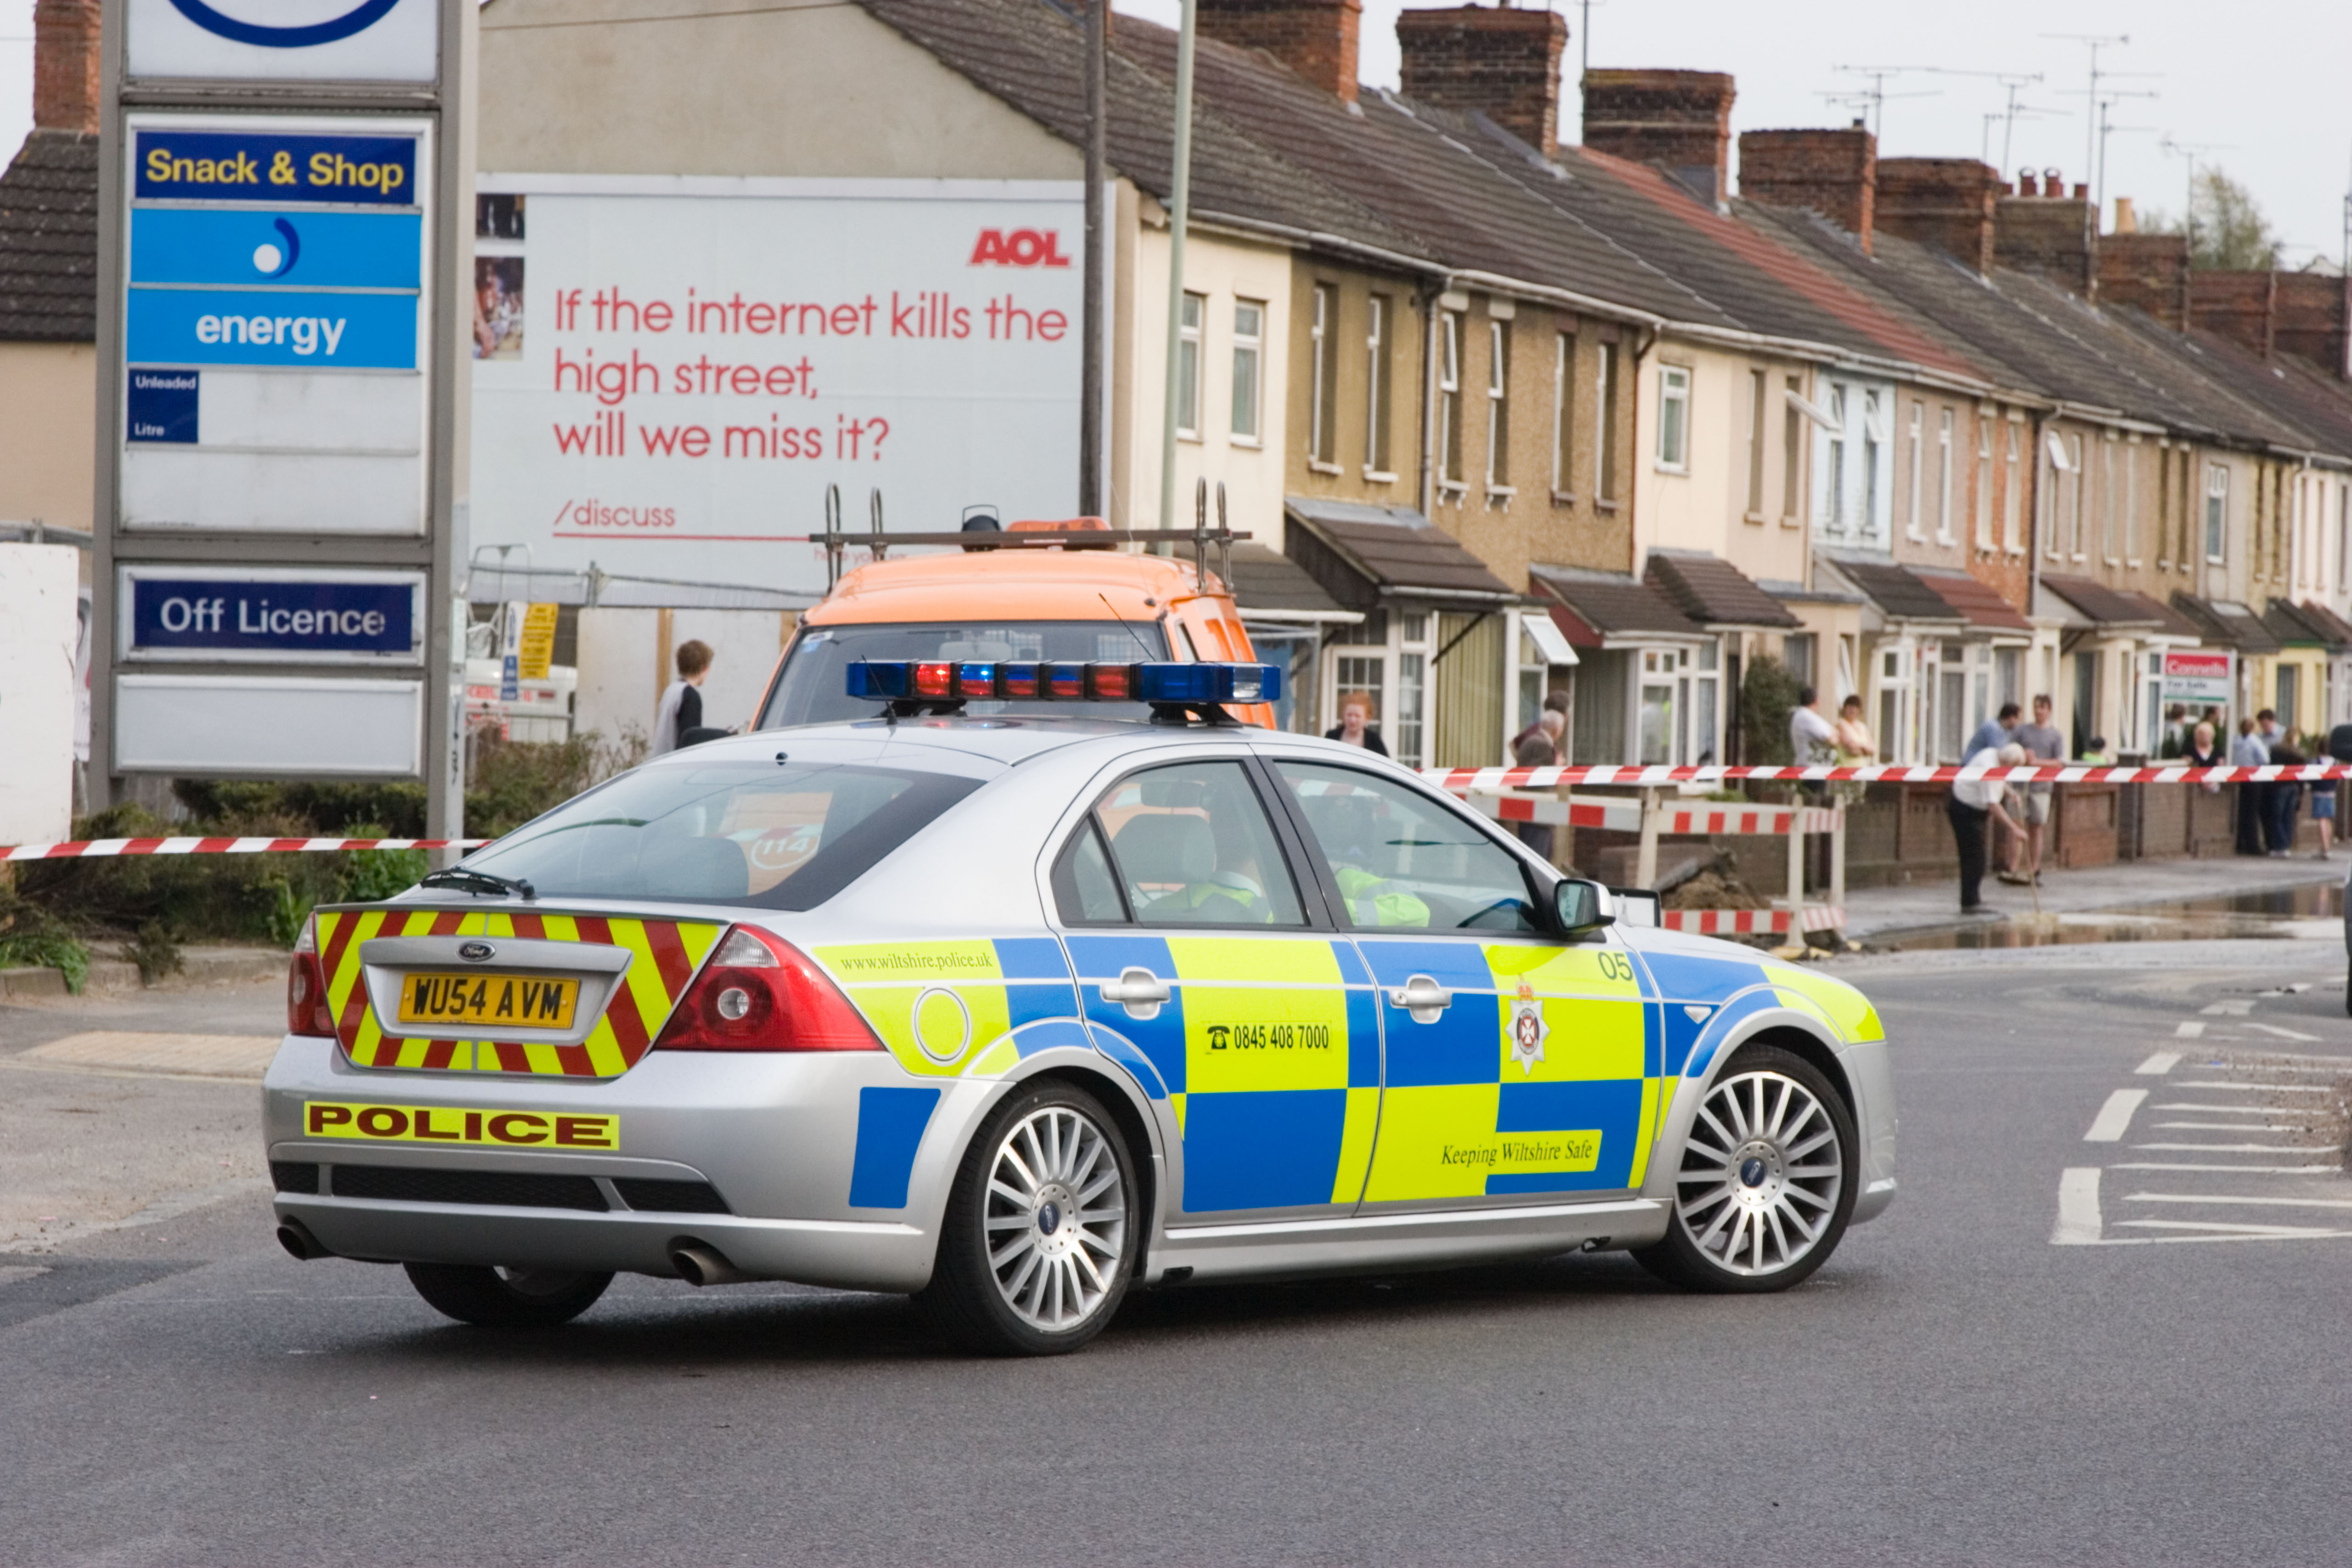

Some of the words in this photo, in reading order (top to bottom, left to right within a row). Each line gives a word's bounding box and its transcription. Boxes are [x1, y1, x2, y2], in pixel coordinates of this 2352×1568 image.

[147, 149, 258, 183] Snack
[268, 151, 297, 185] &
[308, 152, 404, 194] Shop
[968, 229, 1071, 267] AOL
[555, 289, 582, 331] If
[591, 286, 674, 333] the
[688, 287, 878, 336] internet
[891, 291, 971, 339] kills
[984, 294, 1068, 342] the
[196, 315, 347, 355] energy
[136, 375, 196, 389] Unleaded
[554, 348, 660, 406] high
[674, 355, 818, 399] street,
[135, 423, 164, 436] Litre
[553, 411, 624, 456] will
[639, 424, 712, 457] we
[724, 412, 823, 459] miss
[837, 413, 889, 460] it?
[553, 499, 675, 527] /discuss
[161, 598, 224, 632] Off
[238, 599, 385, 636] Licence
[762, 836, 810, 855] 114
[841, 952, 993, 970] www.wiltshire.police.uk
[1598, 952, 1634, 981] 05
[413, 978, 487, 1015] WU54
[496, 980, 563, 1021] AVM
[1234, 1025, 1266, 1049] 0845
[1270, 1025, 1294, 1049] 408
[1298, 1025, 1329, 1049] 7000
[310, 1105, 612, 1147] POLICE
[1441, 1144, 1498, 1168] Keeping
[1502, 1141, 1561, 1162] Wiltshire
[1565, 1139, 1592, 1159] Safe
